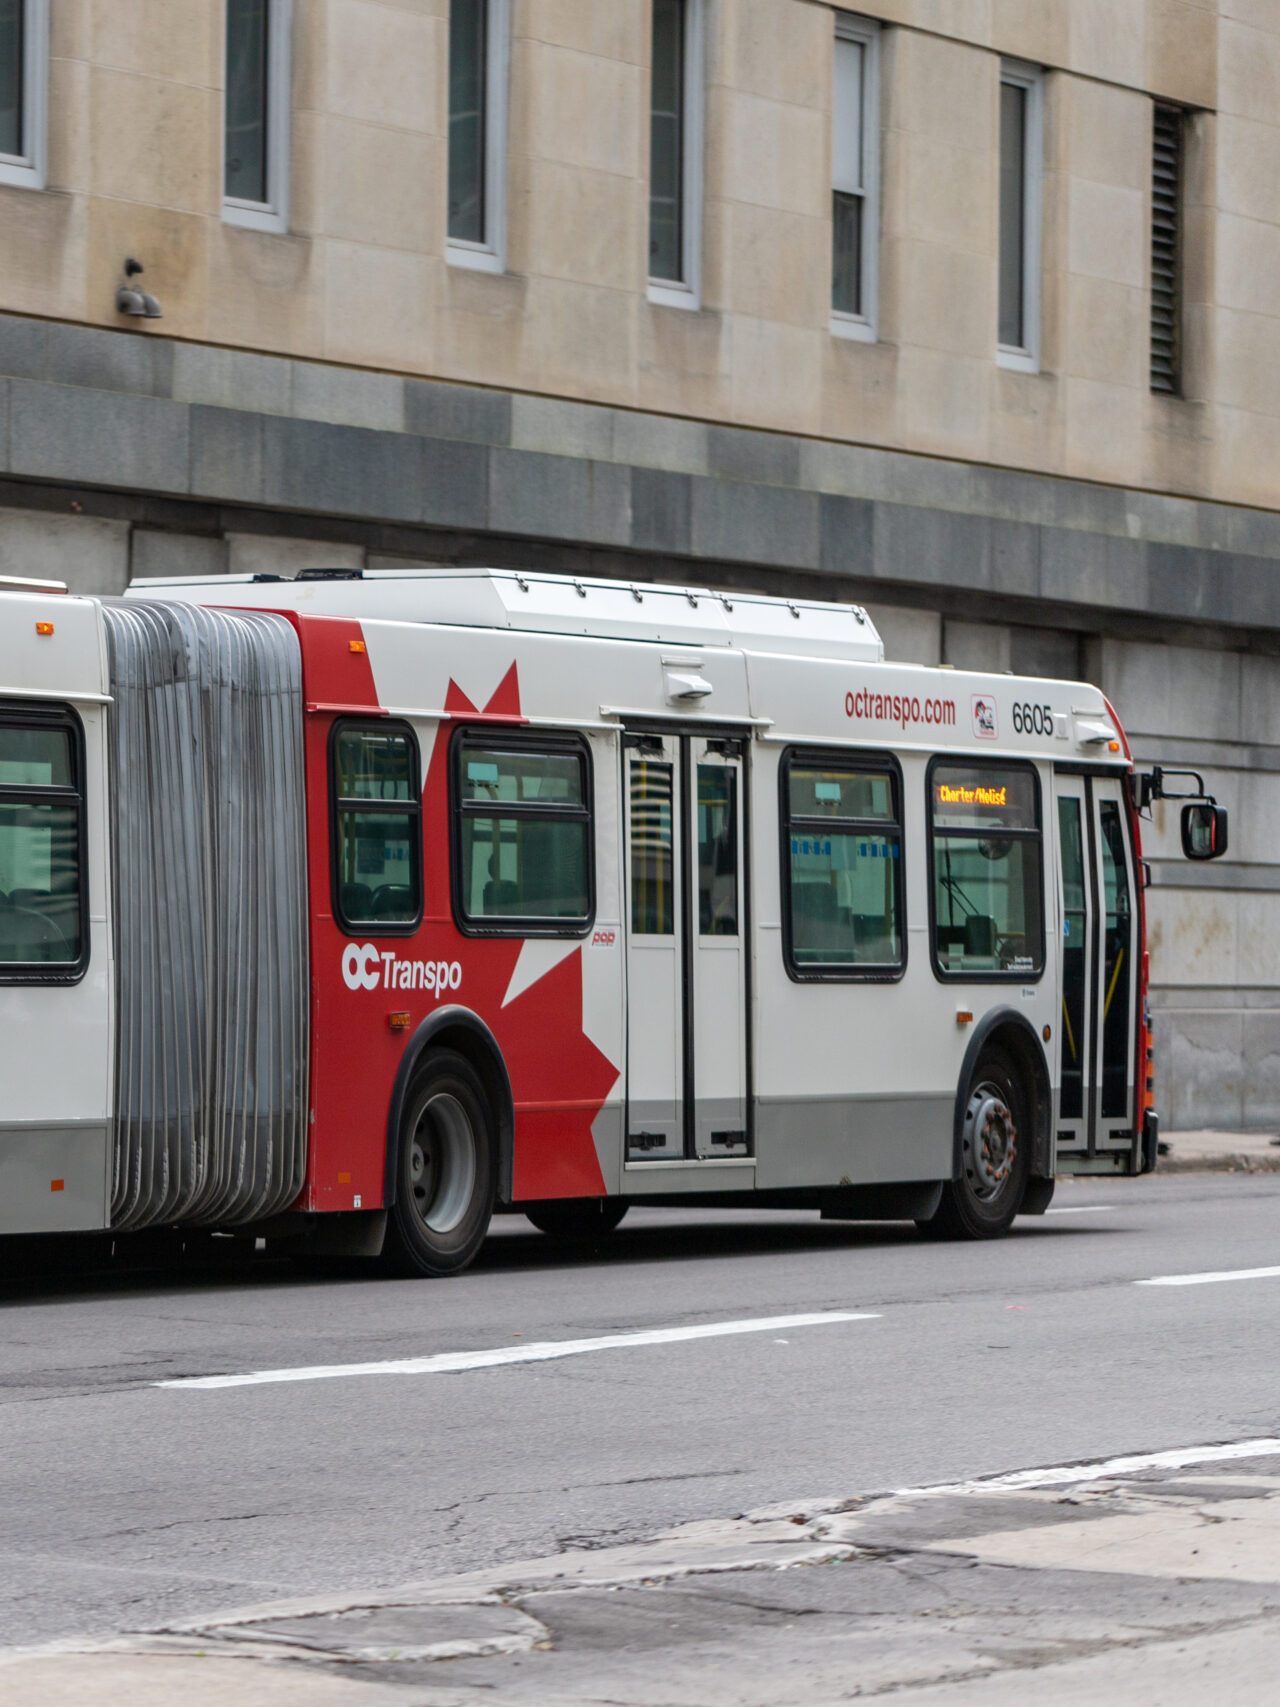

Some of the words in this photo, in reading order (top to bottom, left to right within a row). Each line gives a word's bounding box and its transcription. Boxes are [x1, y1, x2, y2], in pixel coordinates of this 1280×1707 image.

[845, 687, 956, 730] octranspo.com
[1012, 702, 1054, 736] 6605
[592, 932, 616, 947] pop
[341, 943, 380, 990] OC
[380, 952, 462, 999] Transpo
